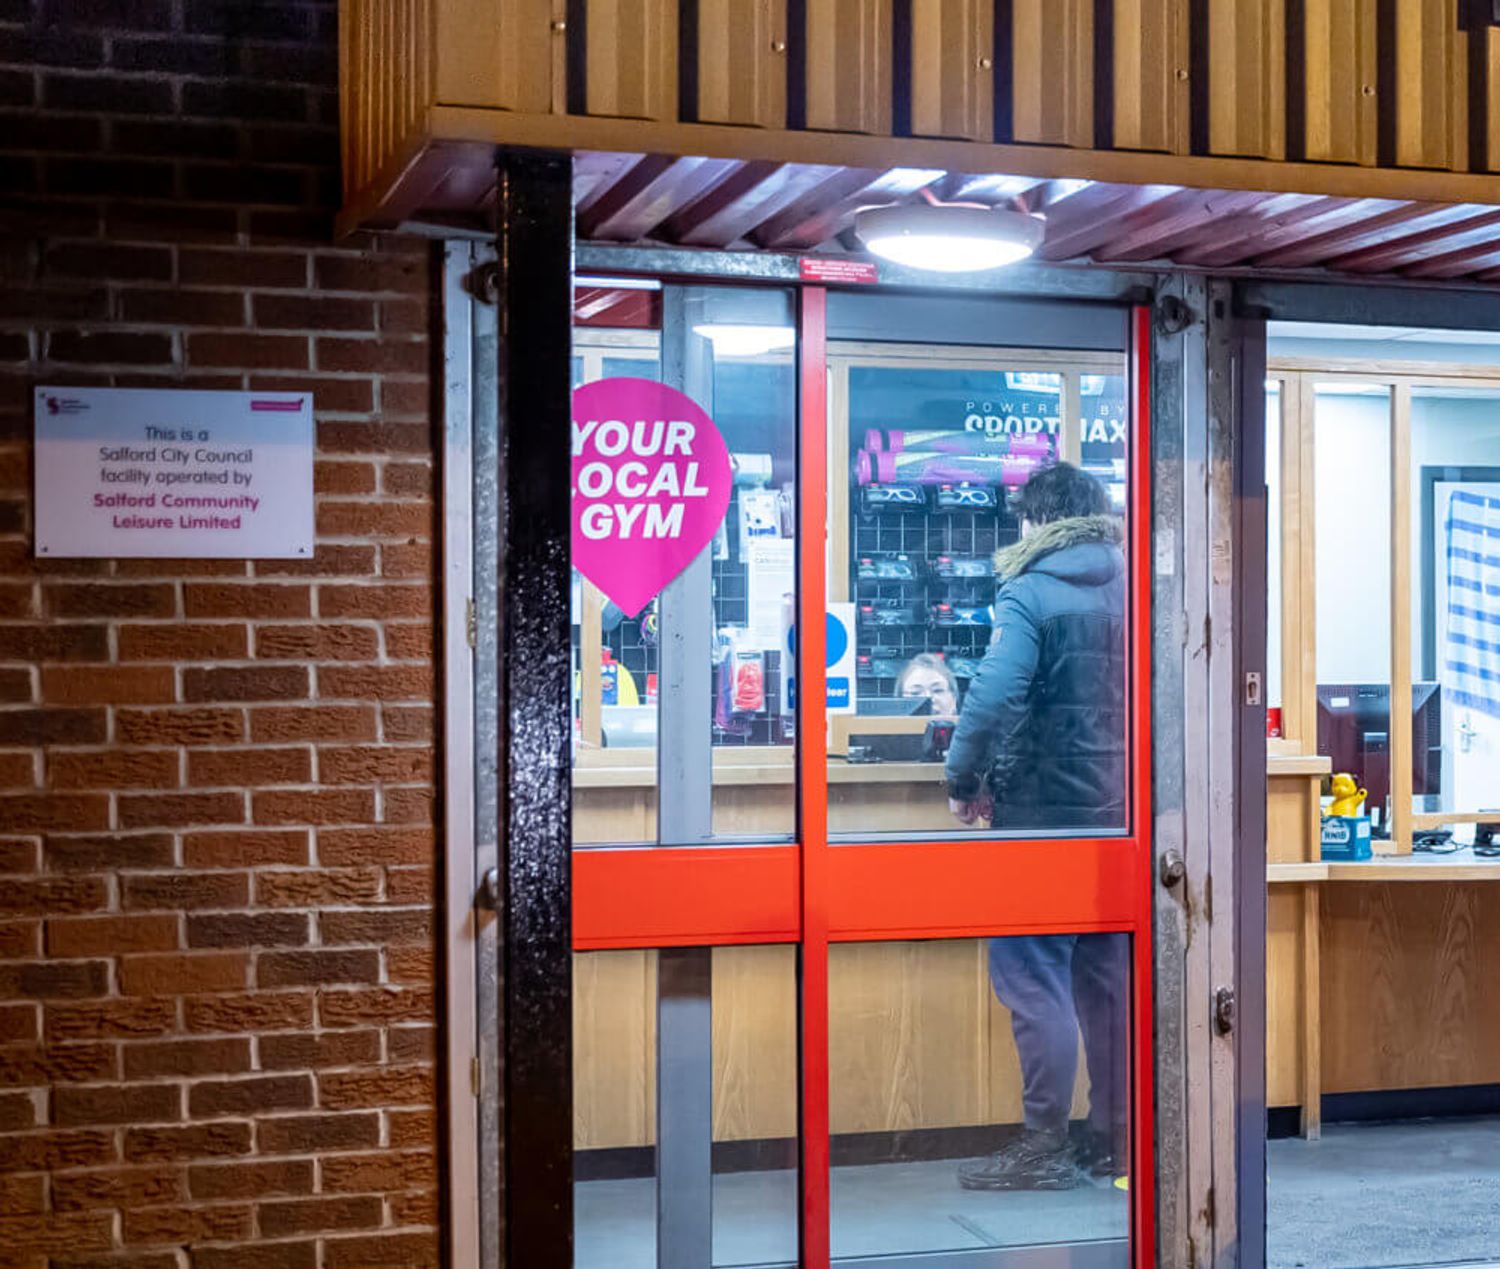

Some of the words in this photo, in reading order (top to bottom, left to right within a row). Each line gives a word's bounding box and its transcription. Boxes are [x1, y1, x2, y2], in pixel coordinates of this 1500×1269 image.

[966, 402, 1066, 414] POWERE
[1101, 405, 1125, 416] BY
[145, 426, 177, 441] This
[181, 428, 193, 441] is
[198, 430, 209, 441] a
[965, 414, 1126, 443] SPORTAX
[572, 420, 696, 456] YOUR
[100, 447, 156, 462] Salford
[161, 448, 189, 465] City
[195, 449, 253, 463] Council
[101, 469, 150, 485] facility
[156, 470, 228, 485] operated
[233, 471, 252, 487] by
[572, 461, 709, 498] OCAL
[94, 493, 156, 508] Salford
[162, 494, 259, 511] Community
[113, 515, 174, 529] Leisure
[180, 515, 241, 529] Limited
[580, 503, 685, 539] GYM
